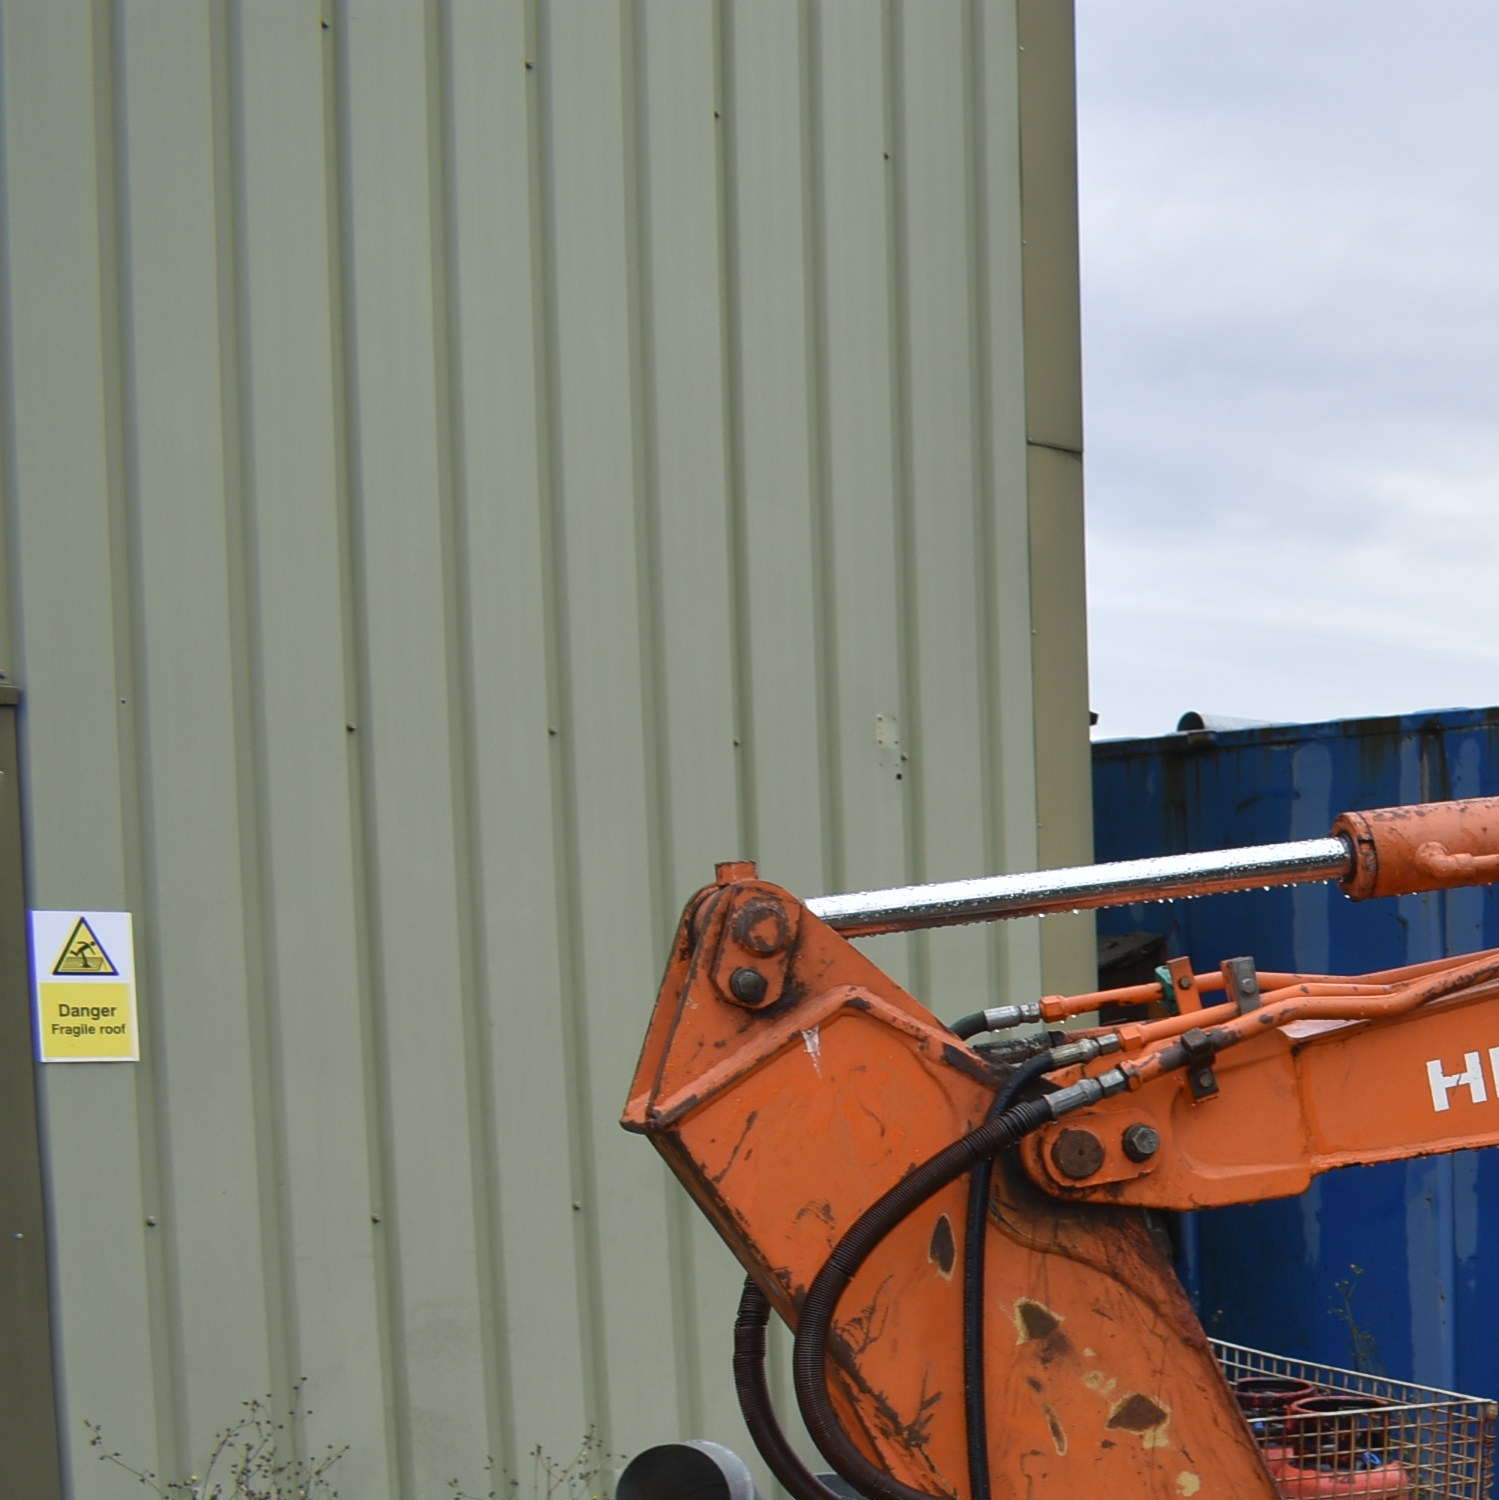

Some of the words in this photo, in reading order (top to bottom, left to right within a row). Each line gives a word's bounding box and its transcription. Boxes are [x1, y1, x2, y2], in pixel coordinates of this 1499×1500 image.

[58, 1003, 117, 1021] Danger
[51, 1023, 96, 1037] Fragile
[99, 1023, 126, 1035] roof
